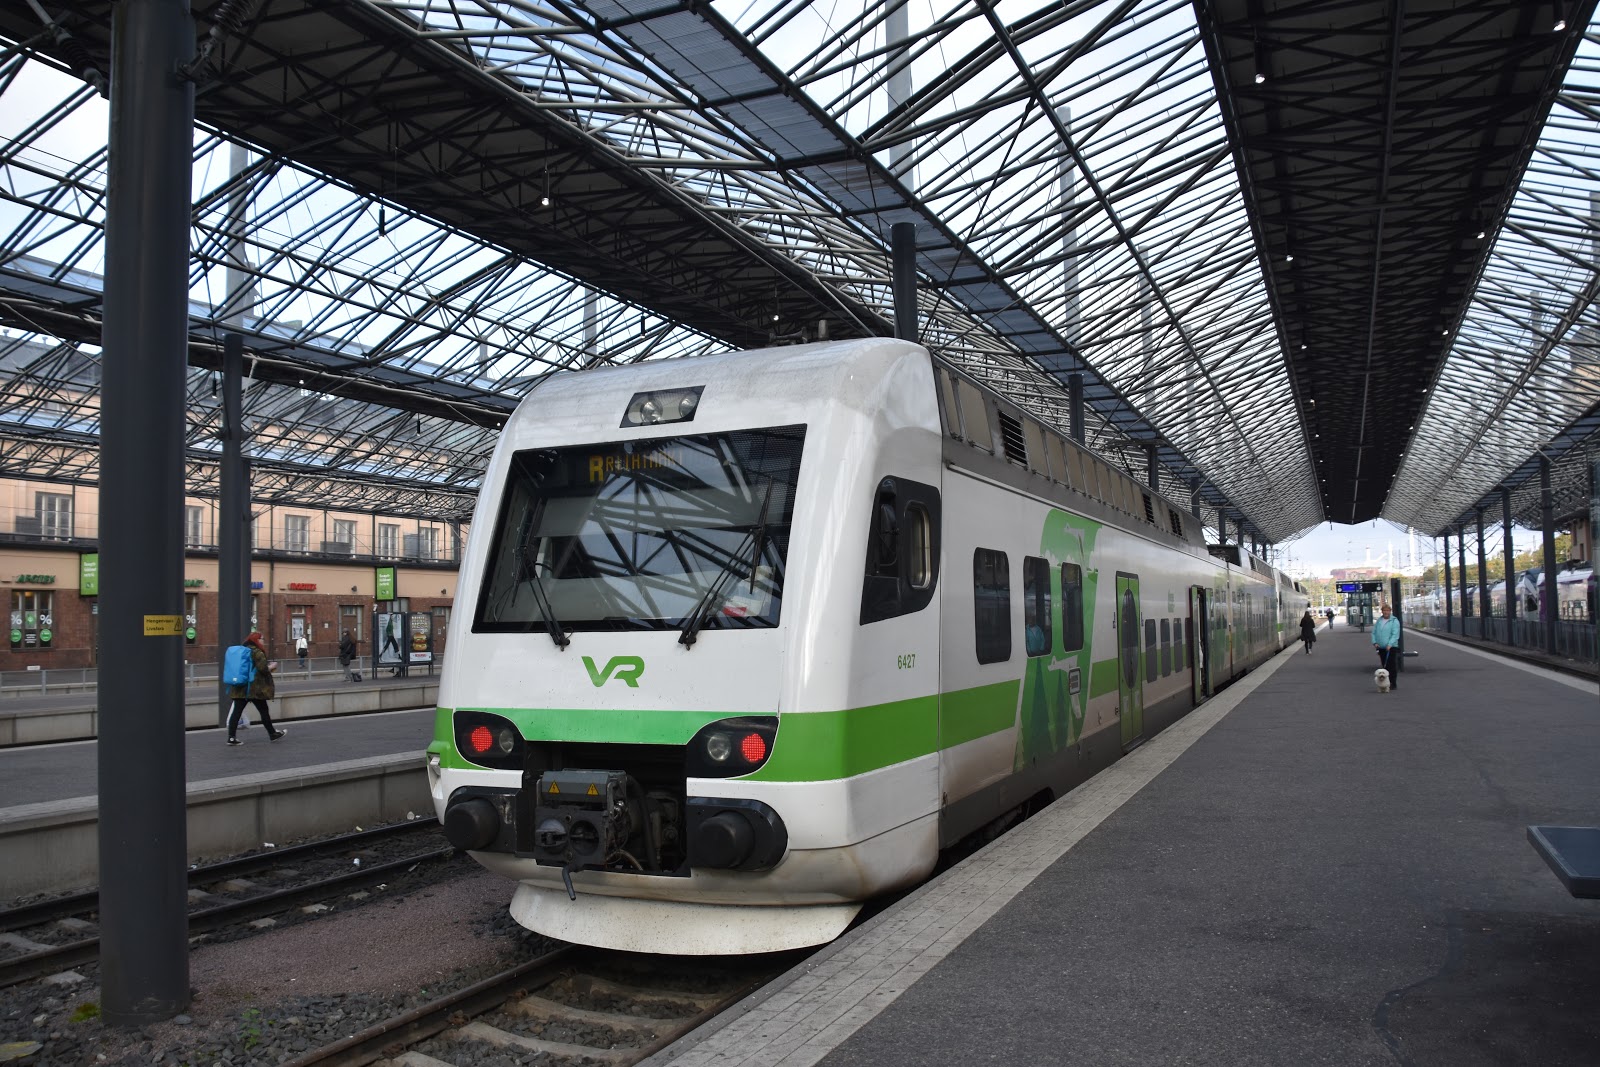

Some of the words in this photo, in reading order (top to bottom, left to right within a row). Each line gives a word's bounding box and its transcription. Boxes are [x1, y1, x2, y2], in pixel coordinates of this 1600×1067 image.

[589, 455, 604, 482] R
[581, 656, 645, 688] VR
[897, 653, 916, 670] 6427
